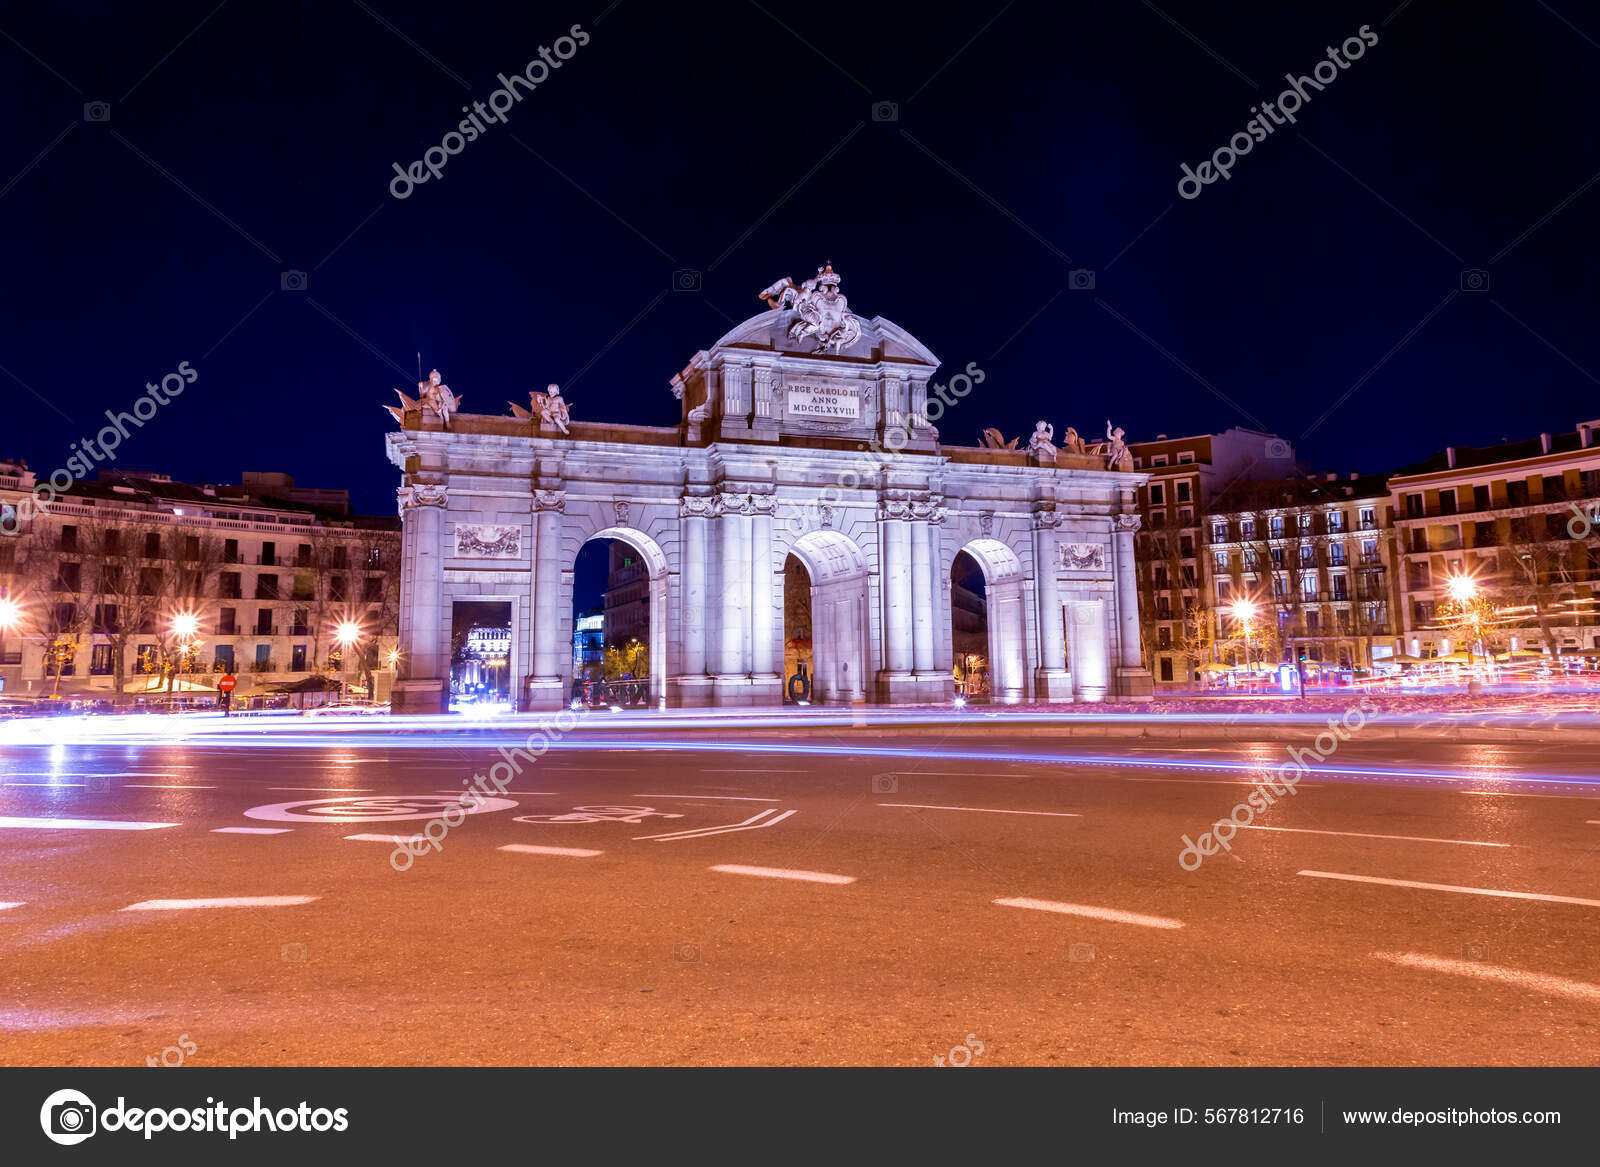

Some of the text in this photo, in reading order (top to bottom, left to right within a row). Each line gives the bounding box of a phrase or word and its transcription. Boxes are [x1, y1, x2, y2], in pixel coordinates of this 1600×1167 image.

[788, 385, 859, 398] REGE CAROLO III
[812, 396, 838, 405] ANNO
[793, 404, 855, 416] MDCCLXXVIII
